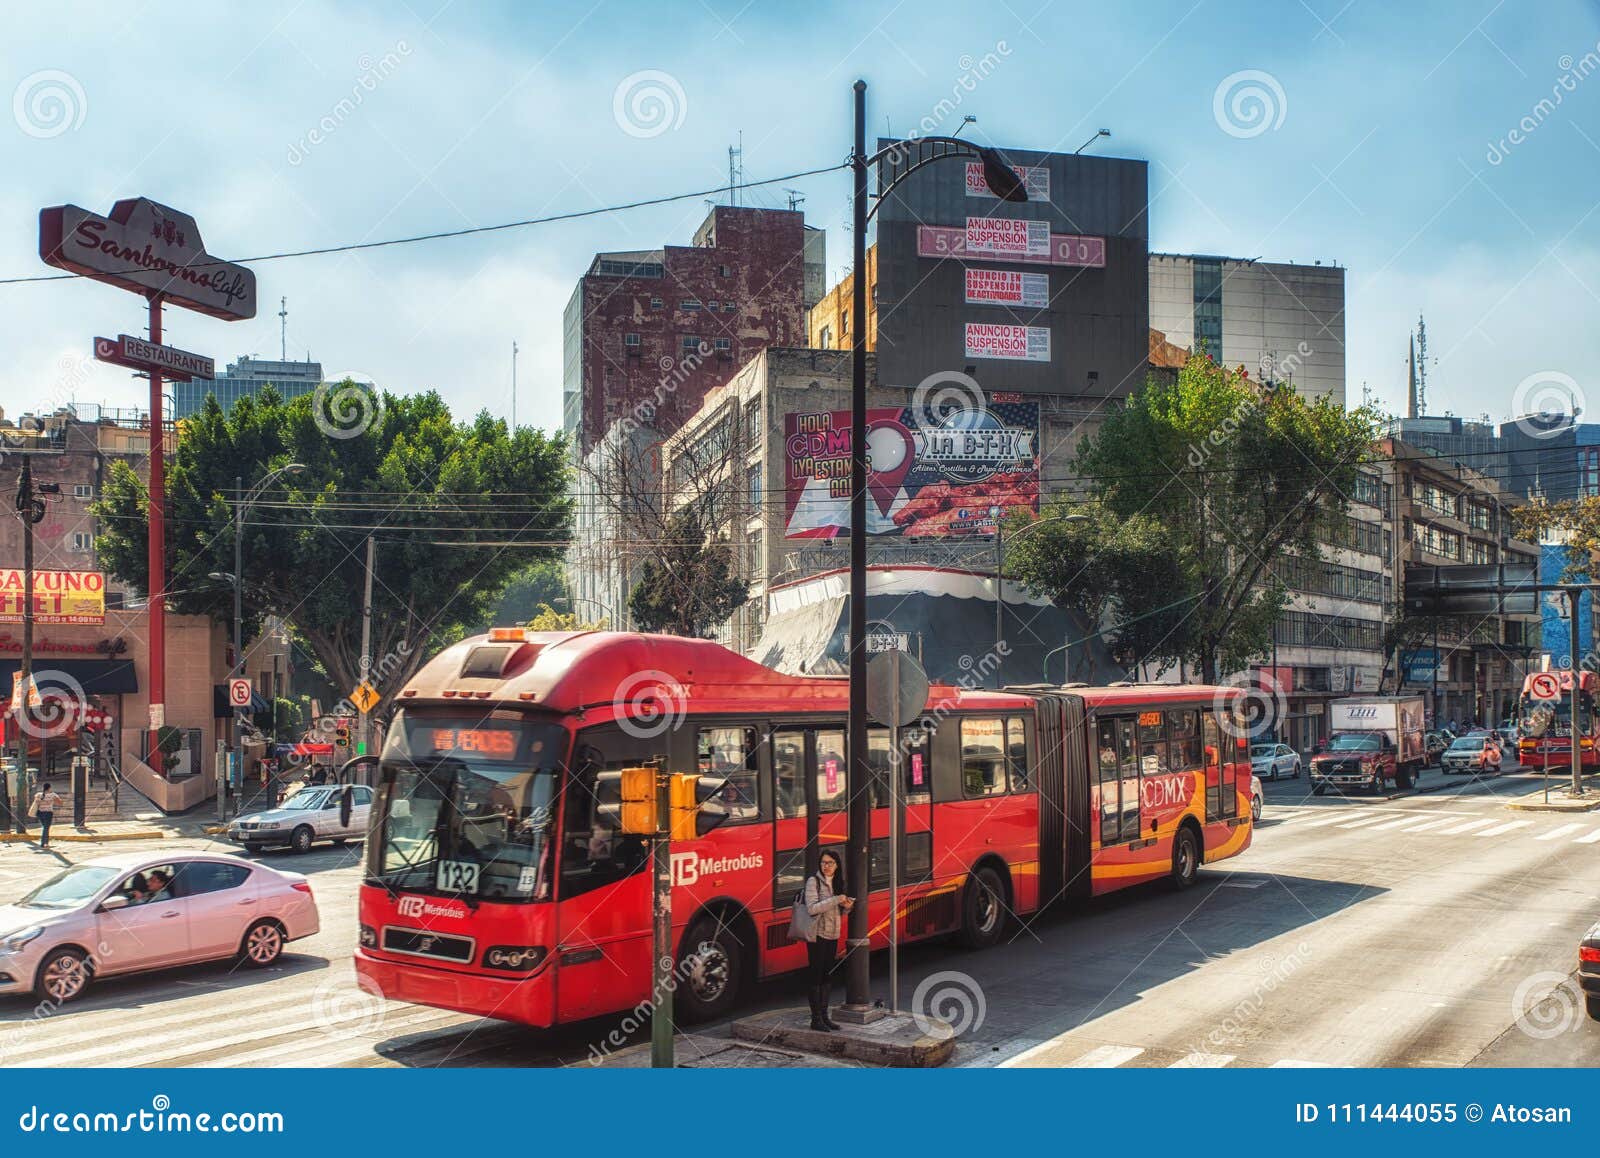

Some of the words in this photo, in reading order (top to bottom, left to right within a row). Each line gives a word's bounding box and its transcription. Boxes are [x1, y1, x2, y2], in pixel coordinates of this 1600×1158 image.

[967, 218, 1011, 231] ANUNCIO
[1013, 221, 1027, 232] EN
[967, 230, 1027, 244] SUSPENSIÓN
[75, 219, 212, 288] Sanborns
[210, 270, 247, 306] Café
[966, 270, 1007, 281] ANUNCIO
[1010, 273, 1021, 282] EN
[966, 324, 1011, 337] ANUNCIO
[1013, 327, 1026, 338] EN
[966, 336, 1026, 350] SUSPENSIÓN
[125, 340, 213, 375] RESTAURANTE
[799, 414, 830, 432] HOLA
[930, 434, 954, 455] LA
[963, 434, 1012, 456] B-T-H
[655, 684, 693, 698] CDMX
[1143, 776, 1187, 808] CDMX
[700, 852, 764, 876] Metrobús
